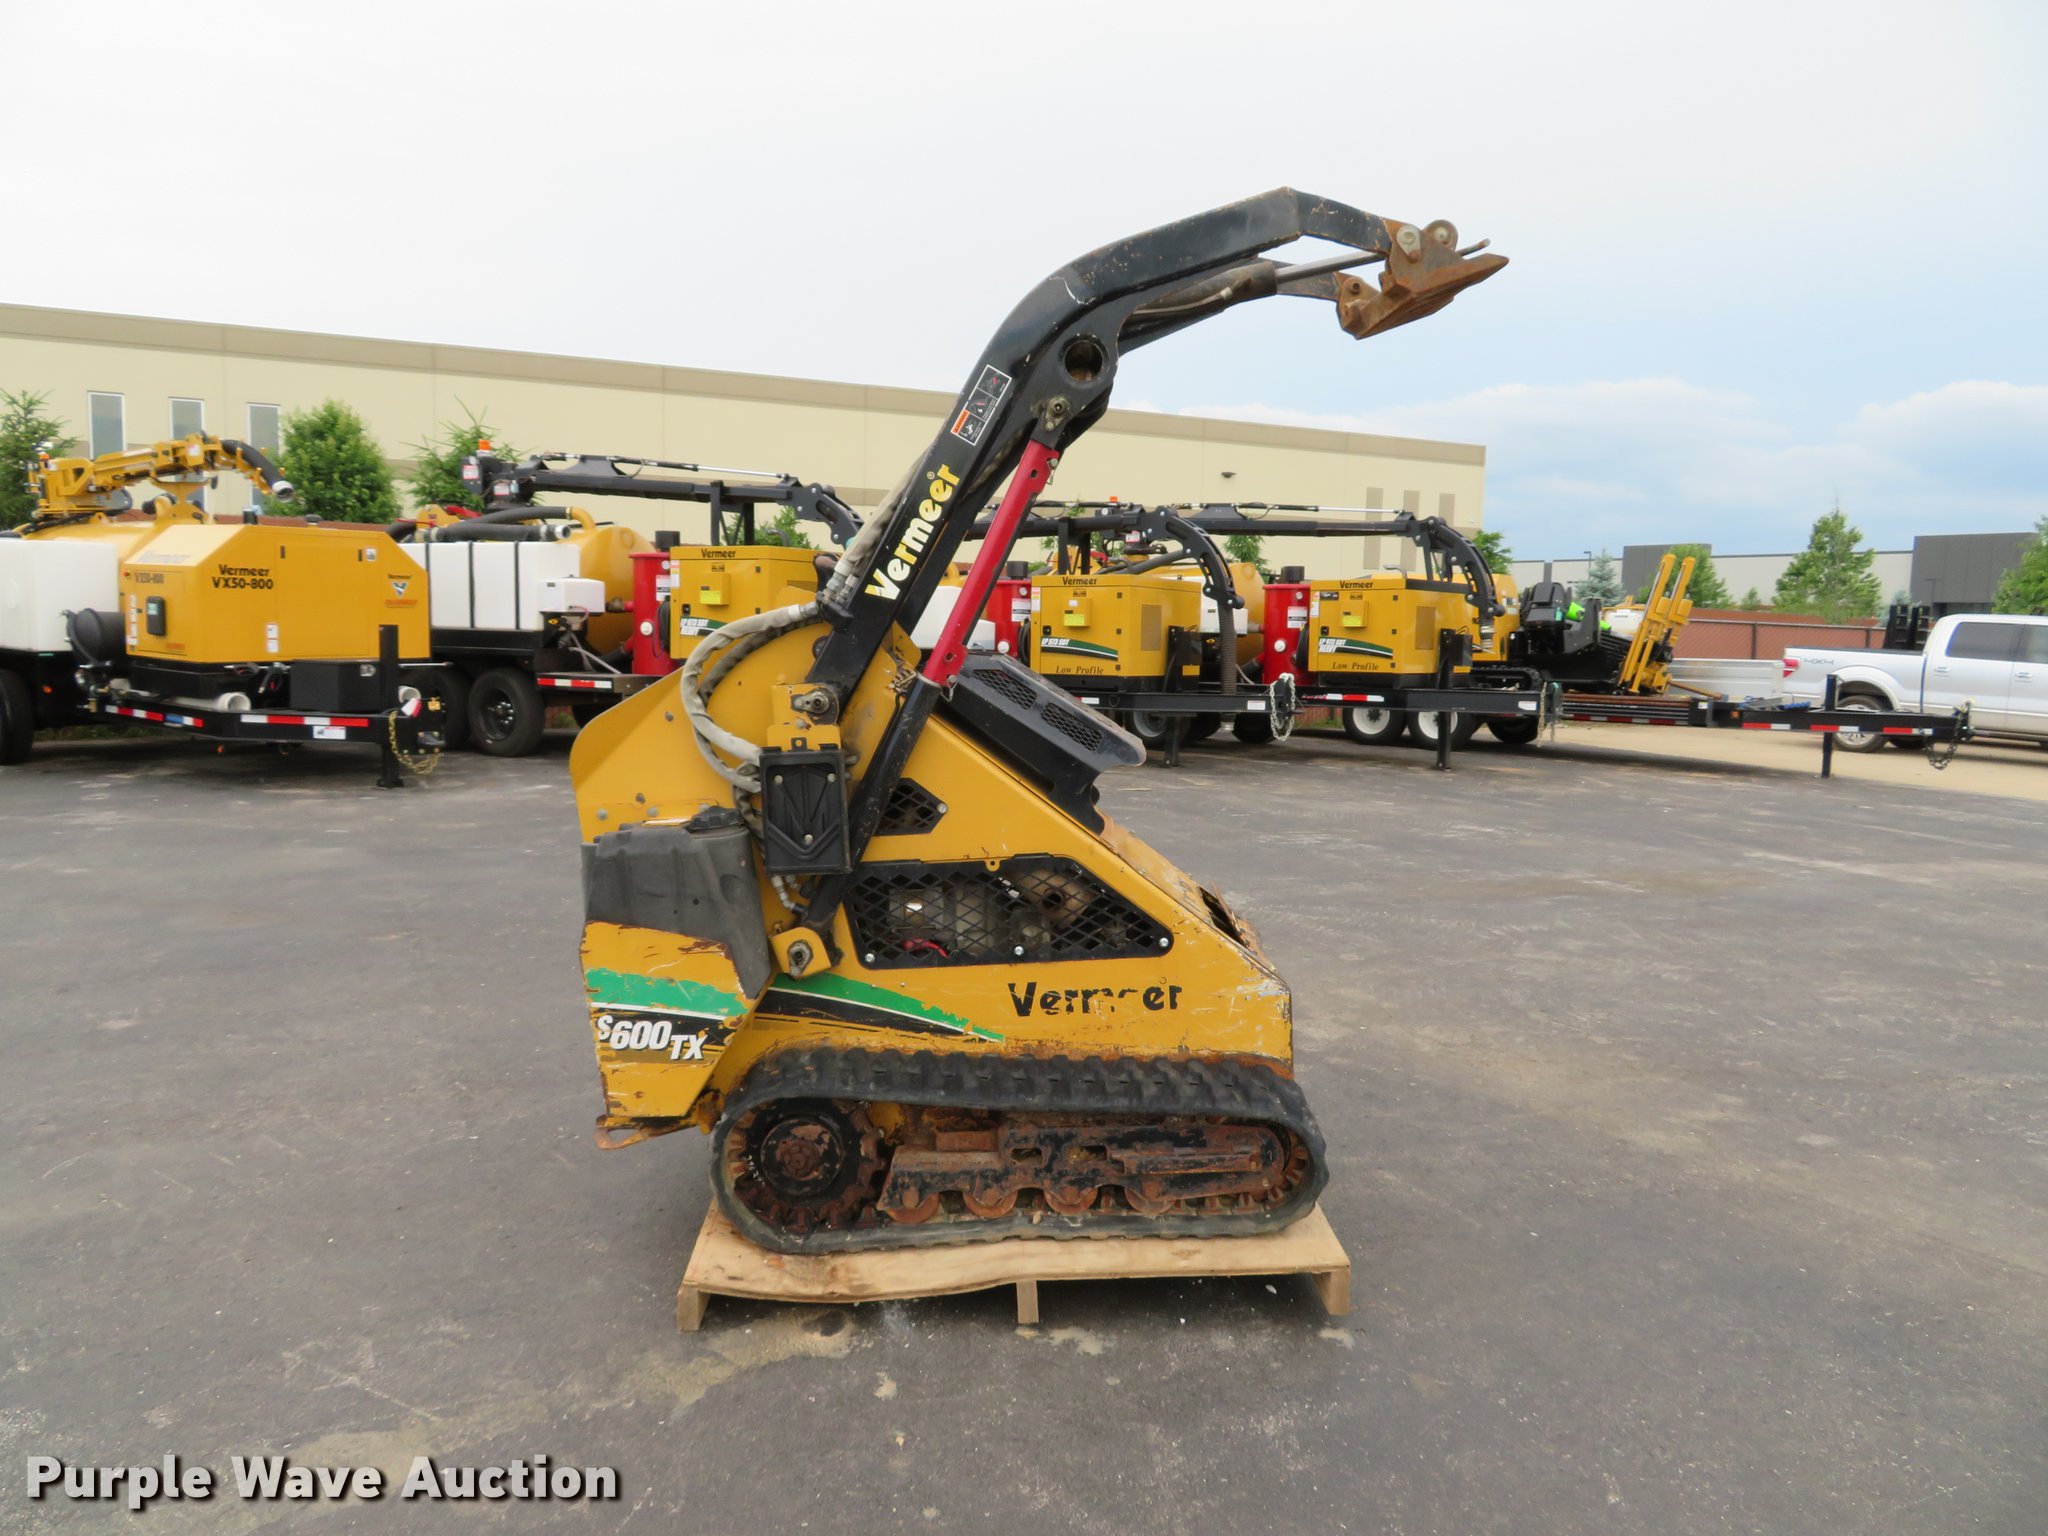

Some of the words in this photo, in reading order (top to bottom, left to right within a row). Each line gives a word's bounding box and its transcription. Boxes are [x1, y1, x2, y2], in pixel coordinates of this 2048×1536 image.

[864, 464, 960, 600] Vermeer
[700, 548, 736, 558] Vermeer
[218, 564, 269, 576] Vermeer
[212, 576, 274, 589] VX50-800
[1062, 576, 1097, 586] Vermeer
[1340, 581, 1374, 589] Vermeer
[1055, 665, 1072, 674] Low
[1075, 665, 1104, 675] Profile
[1332, 662, 1348, 670] Low
[1351, 662, 1380, 671] Profile
